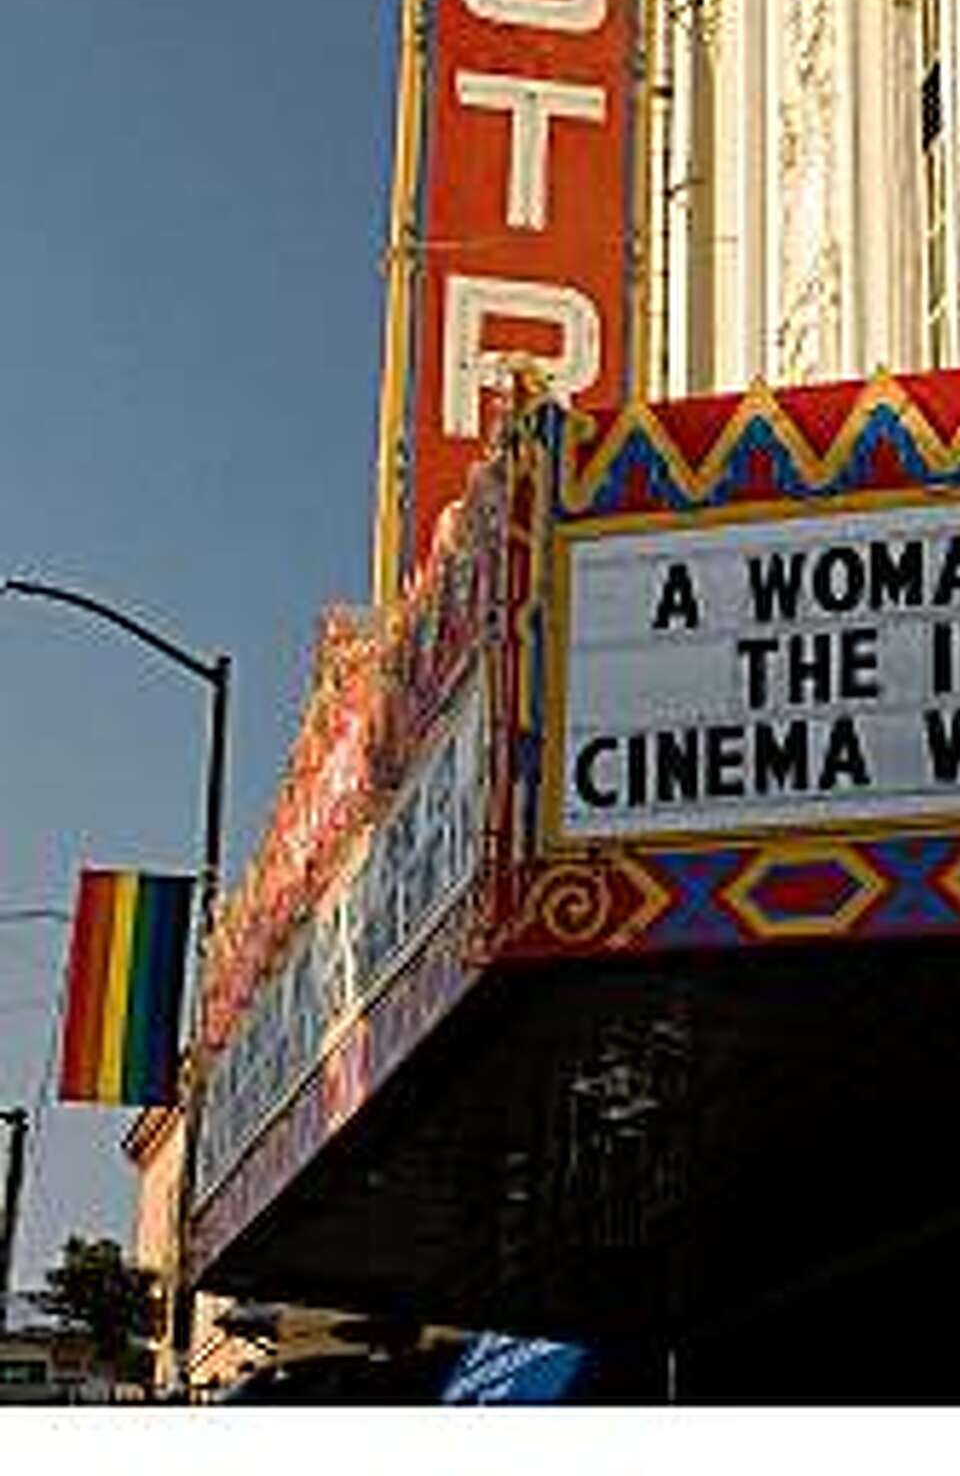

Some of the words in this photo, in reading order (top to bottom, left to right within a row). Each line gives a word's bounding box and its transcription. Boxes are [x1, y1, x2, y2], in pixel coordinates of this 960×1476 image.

[652, 562, 700, 630] A
[737, 628, 881, 710] THE
[575, 712, 870, 808] CINEMA
